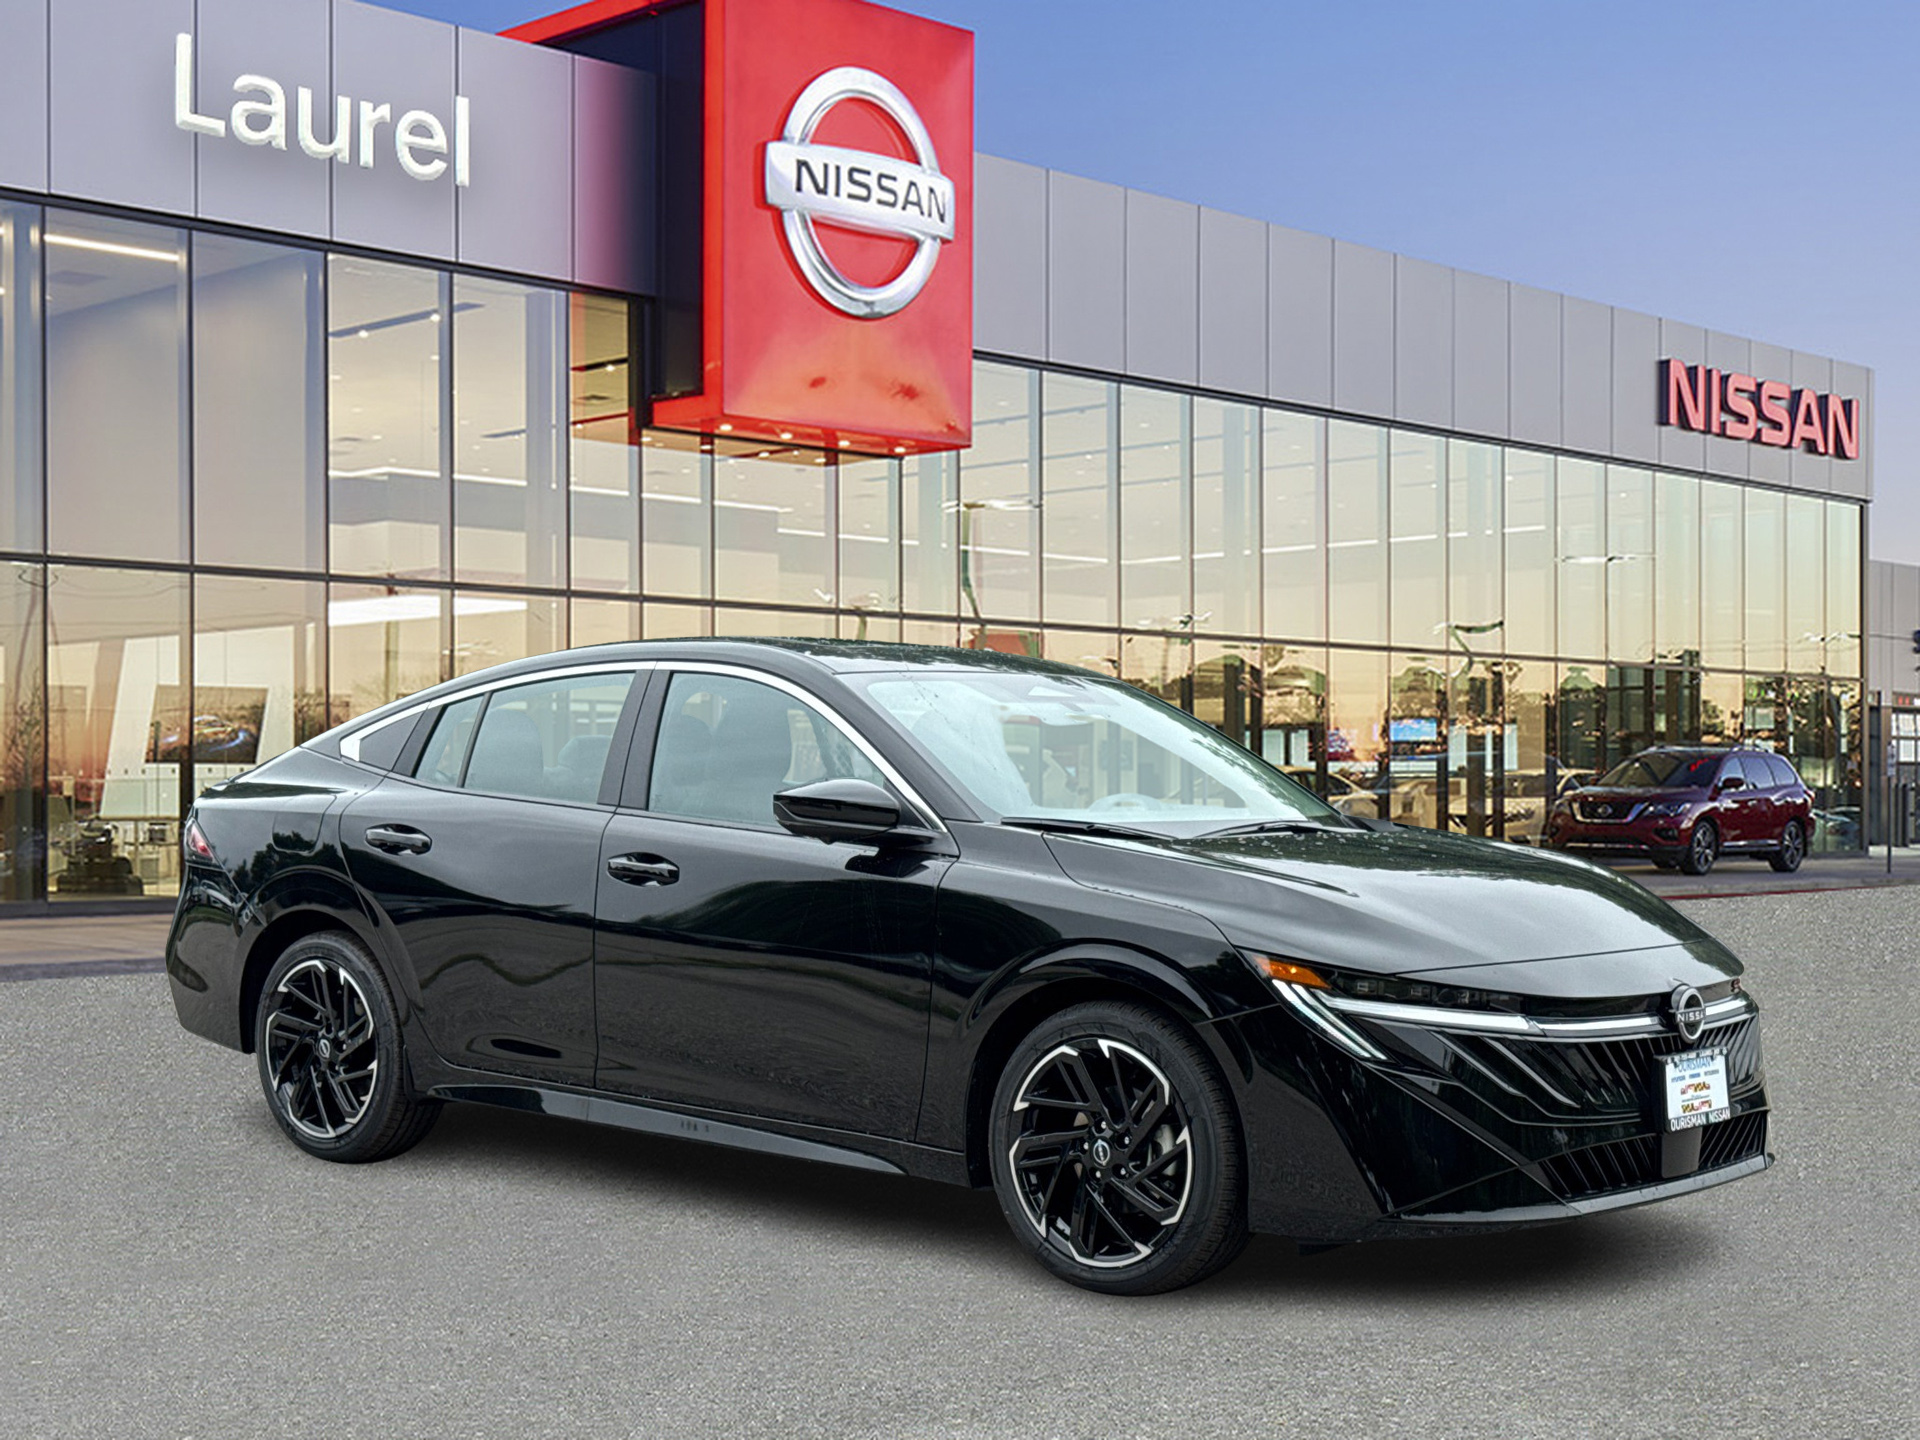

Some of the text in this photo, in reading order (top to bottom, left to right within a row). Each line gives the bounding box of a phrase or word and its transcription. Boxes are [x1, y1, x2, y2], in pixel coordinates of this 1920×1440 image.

[175, 32, 470, 188] Laurel
[795, 158, 947, 224] NISSAN
[1665, 358, 1859, 460] NISSAN
[1677, 1010, 1705, 1022] NISS
[1671, 1108, 1731, 1131] OURISMAN NISSAN
